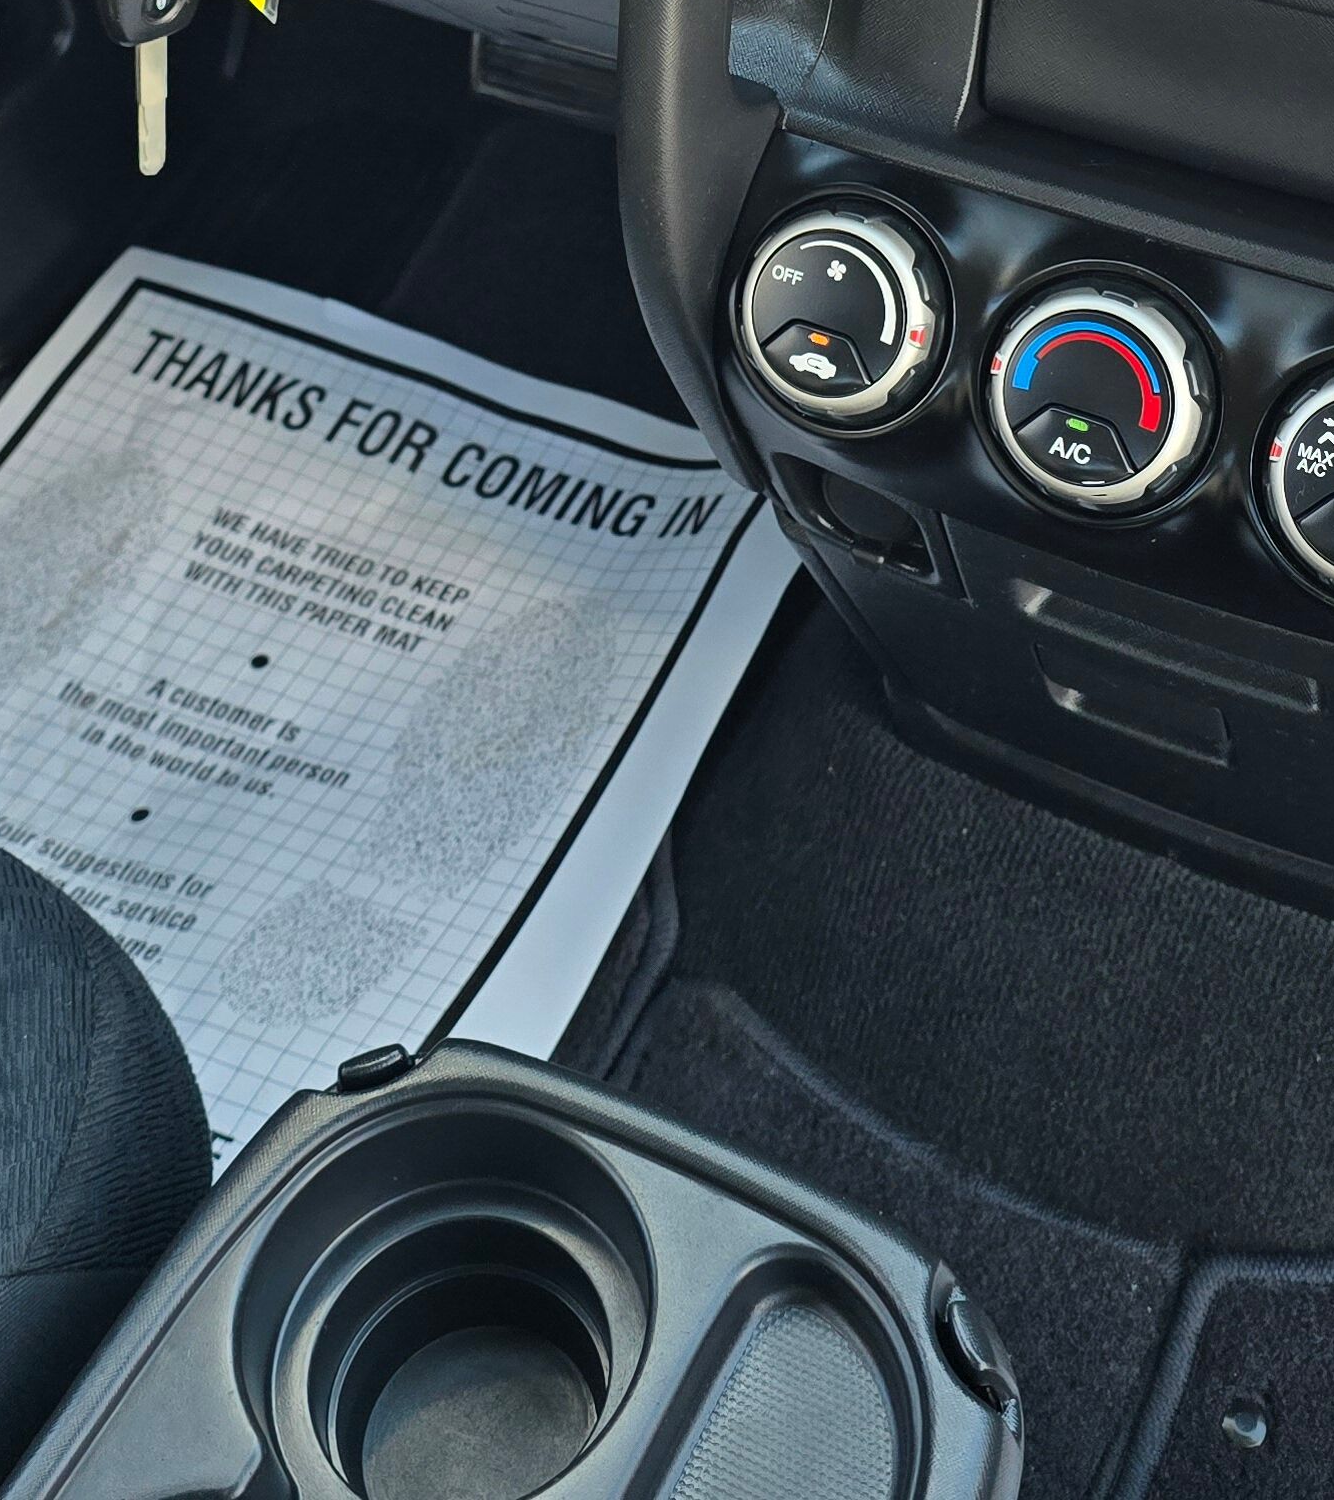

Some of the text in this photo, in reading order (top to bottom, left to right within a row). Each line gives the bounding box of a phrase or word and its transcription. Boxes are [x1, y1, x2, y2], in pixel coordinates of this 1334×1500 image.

[771, 264, 804, 286] OFF
[132, 329, 725, 538] THANKS FOR COMING IN
[1048, 436, 1092, 465] A/C
[1296, 458, 1328, 478] A/C
[192, 530, 455, 632] YOUR CARPETING CLEAN
[213, 506, 470, 605] WE HAVE TRIED TO KEEP
[184, 560, 427, 653] WITH THIS PAPER MAT
[59, 681, 351, 789] the most important person
[146, 678, 302, 743] A customer is
[79, 722, 275, 799] in the world to us.
[37, 837, 177, 892] suggestions
[177, 873, 215, 899] for
[69, 885, 198, 932] our service
